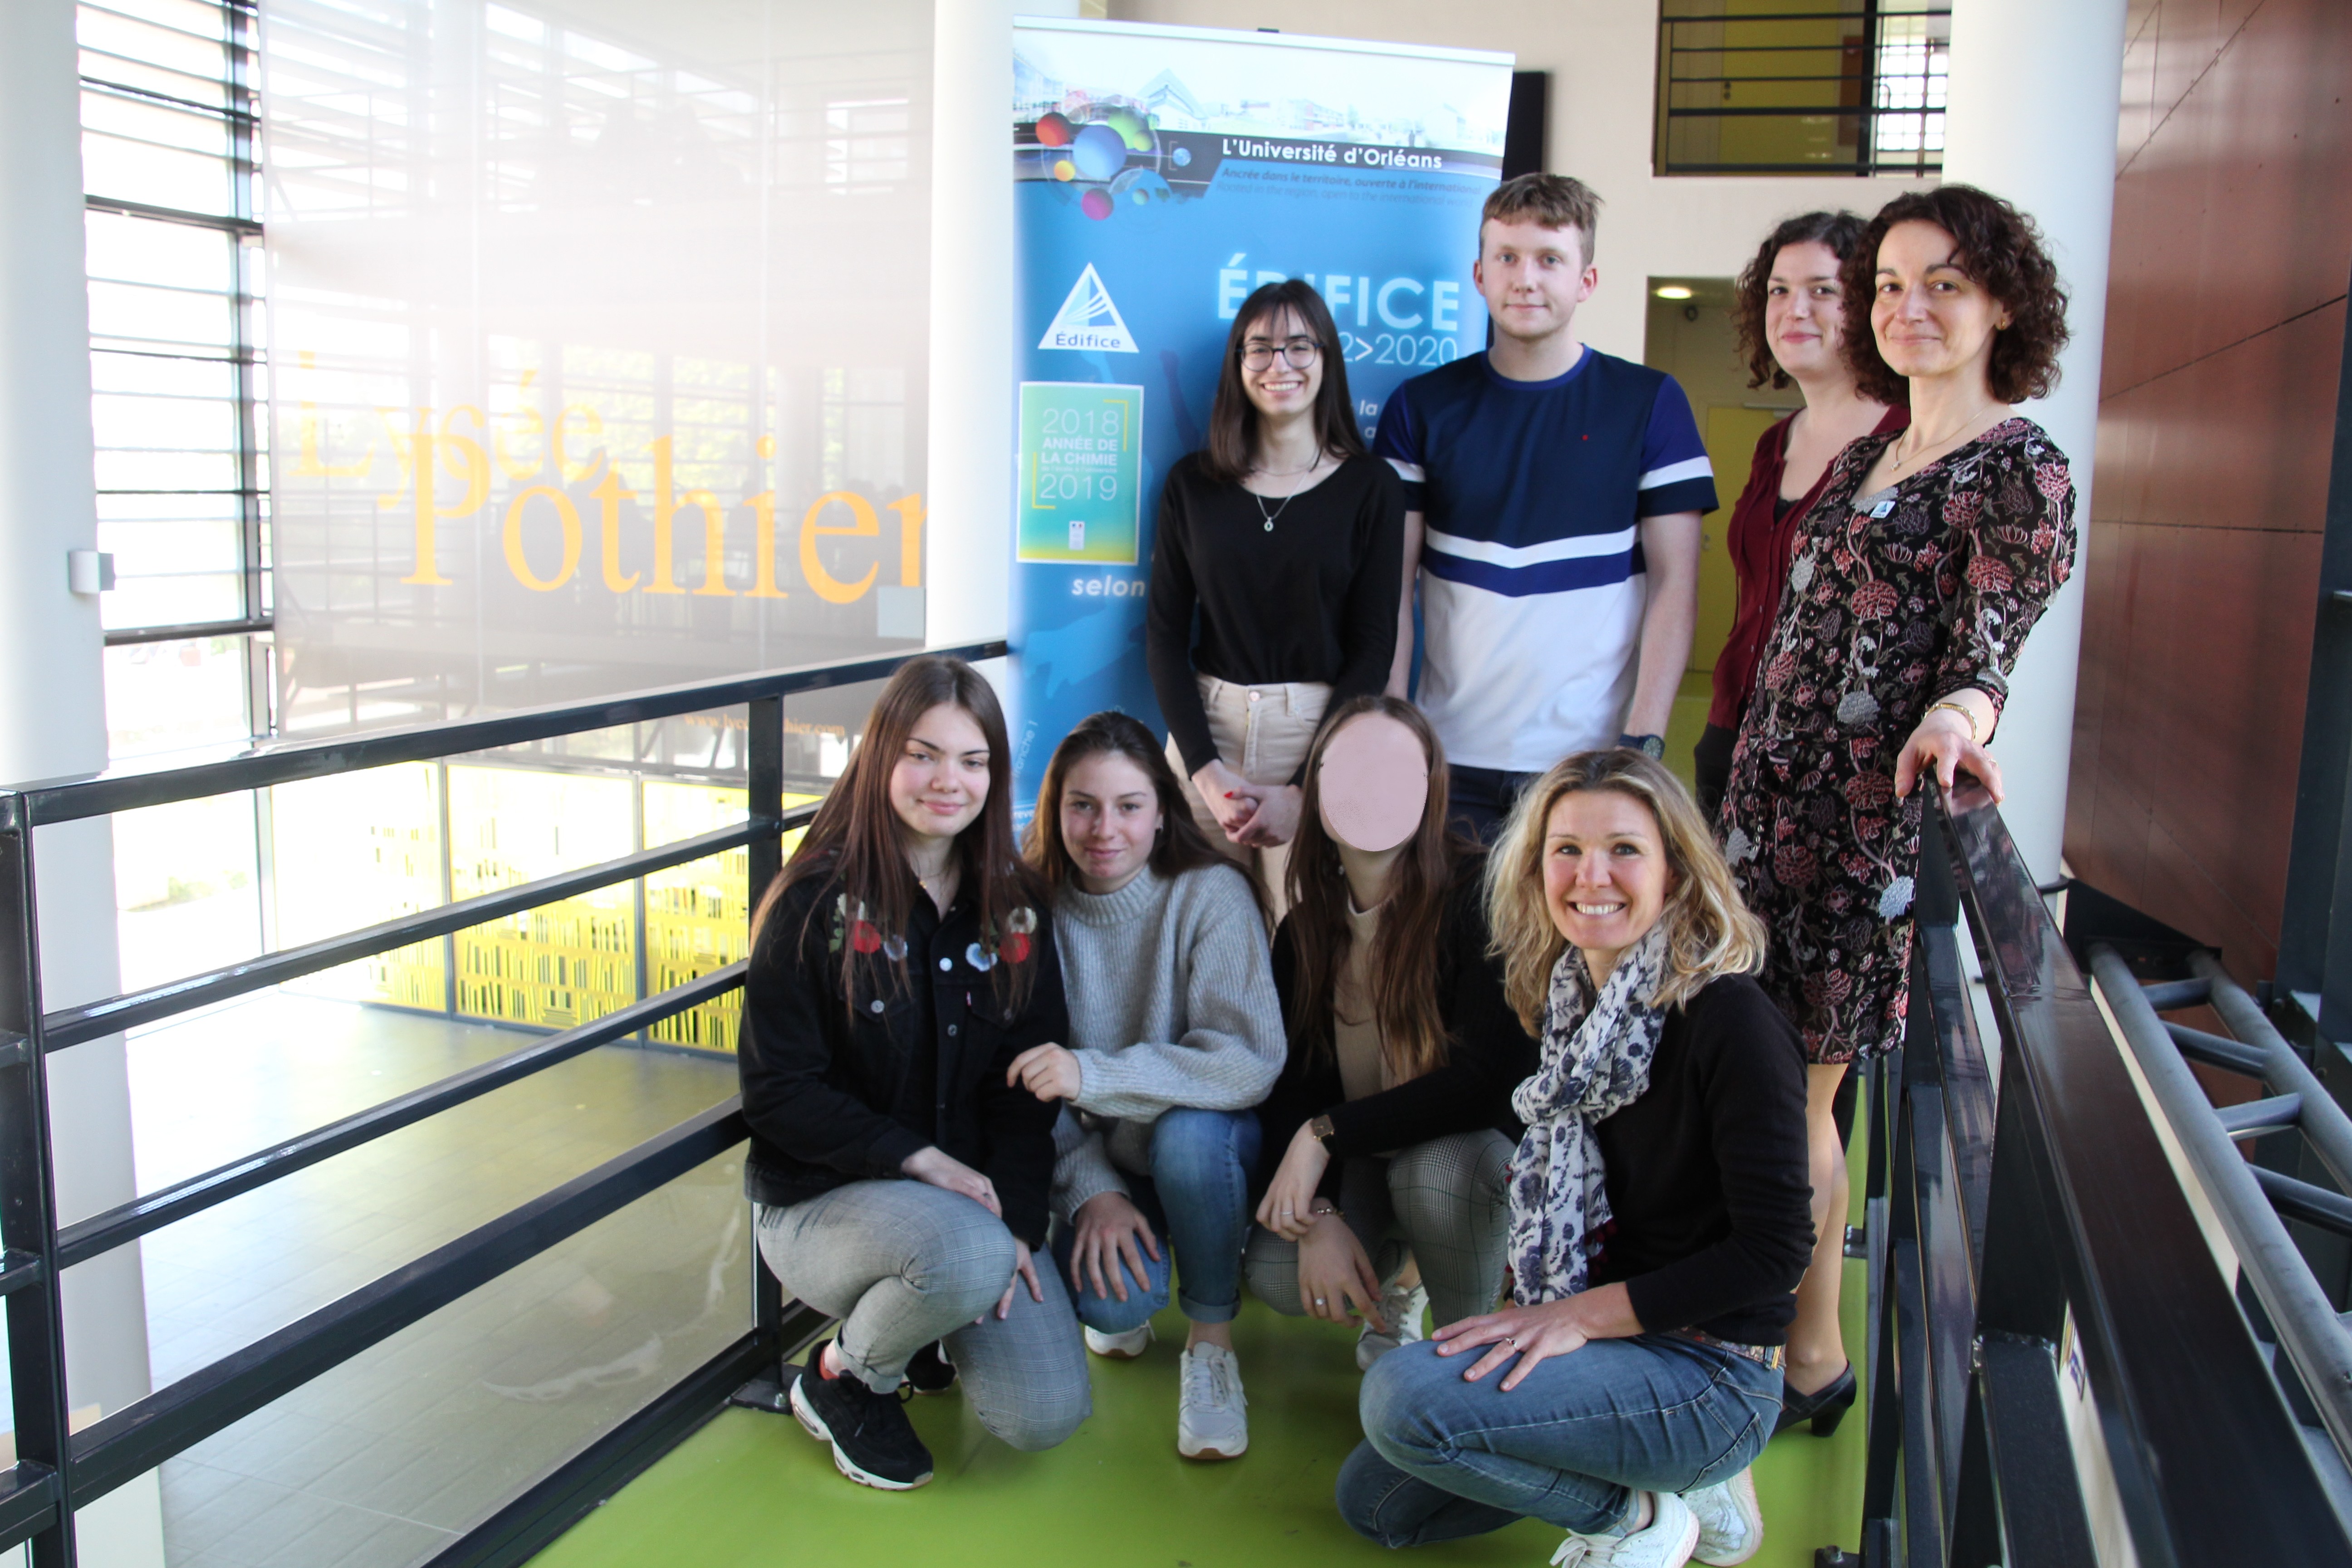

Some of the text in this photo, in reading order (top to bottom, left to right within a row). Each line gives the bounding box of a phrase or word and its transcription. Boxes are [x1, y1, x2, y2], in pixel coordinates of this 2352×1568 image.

[1223, 139, 1442, 169] L'Université d'Orléans
[1218, 253, 1460, 332] ÉFICE
[1056, 331, 1121, 348] Édifice
[1338, 331, 1458, 366] 2>2020
[288, 350, 604, 510] Lycée
[1043, 408, 1120, 436] 2018
[1043, 435, 1118, 451] ANNÉE DE
[1041, 452, 1117, 466] LA CHIMIE
[1040, 473, 1117, 501] 2019
[1071, 574, 1146, 597] selon
